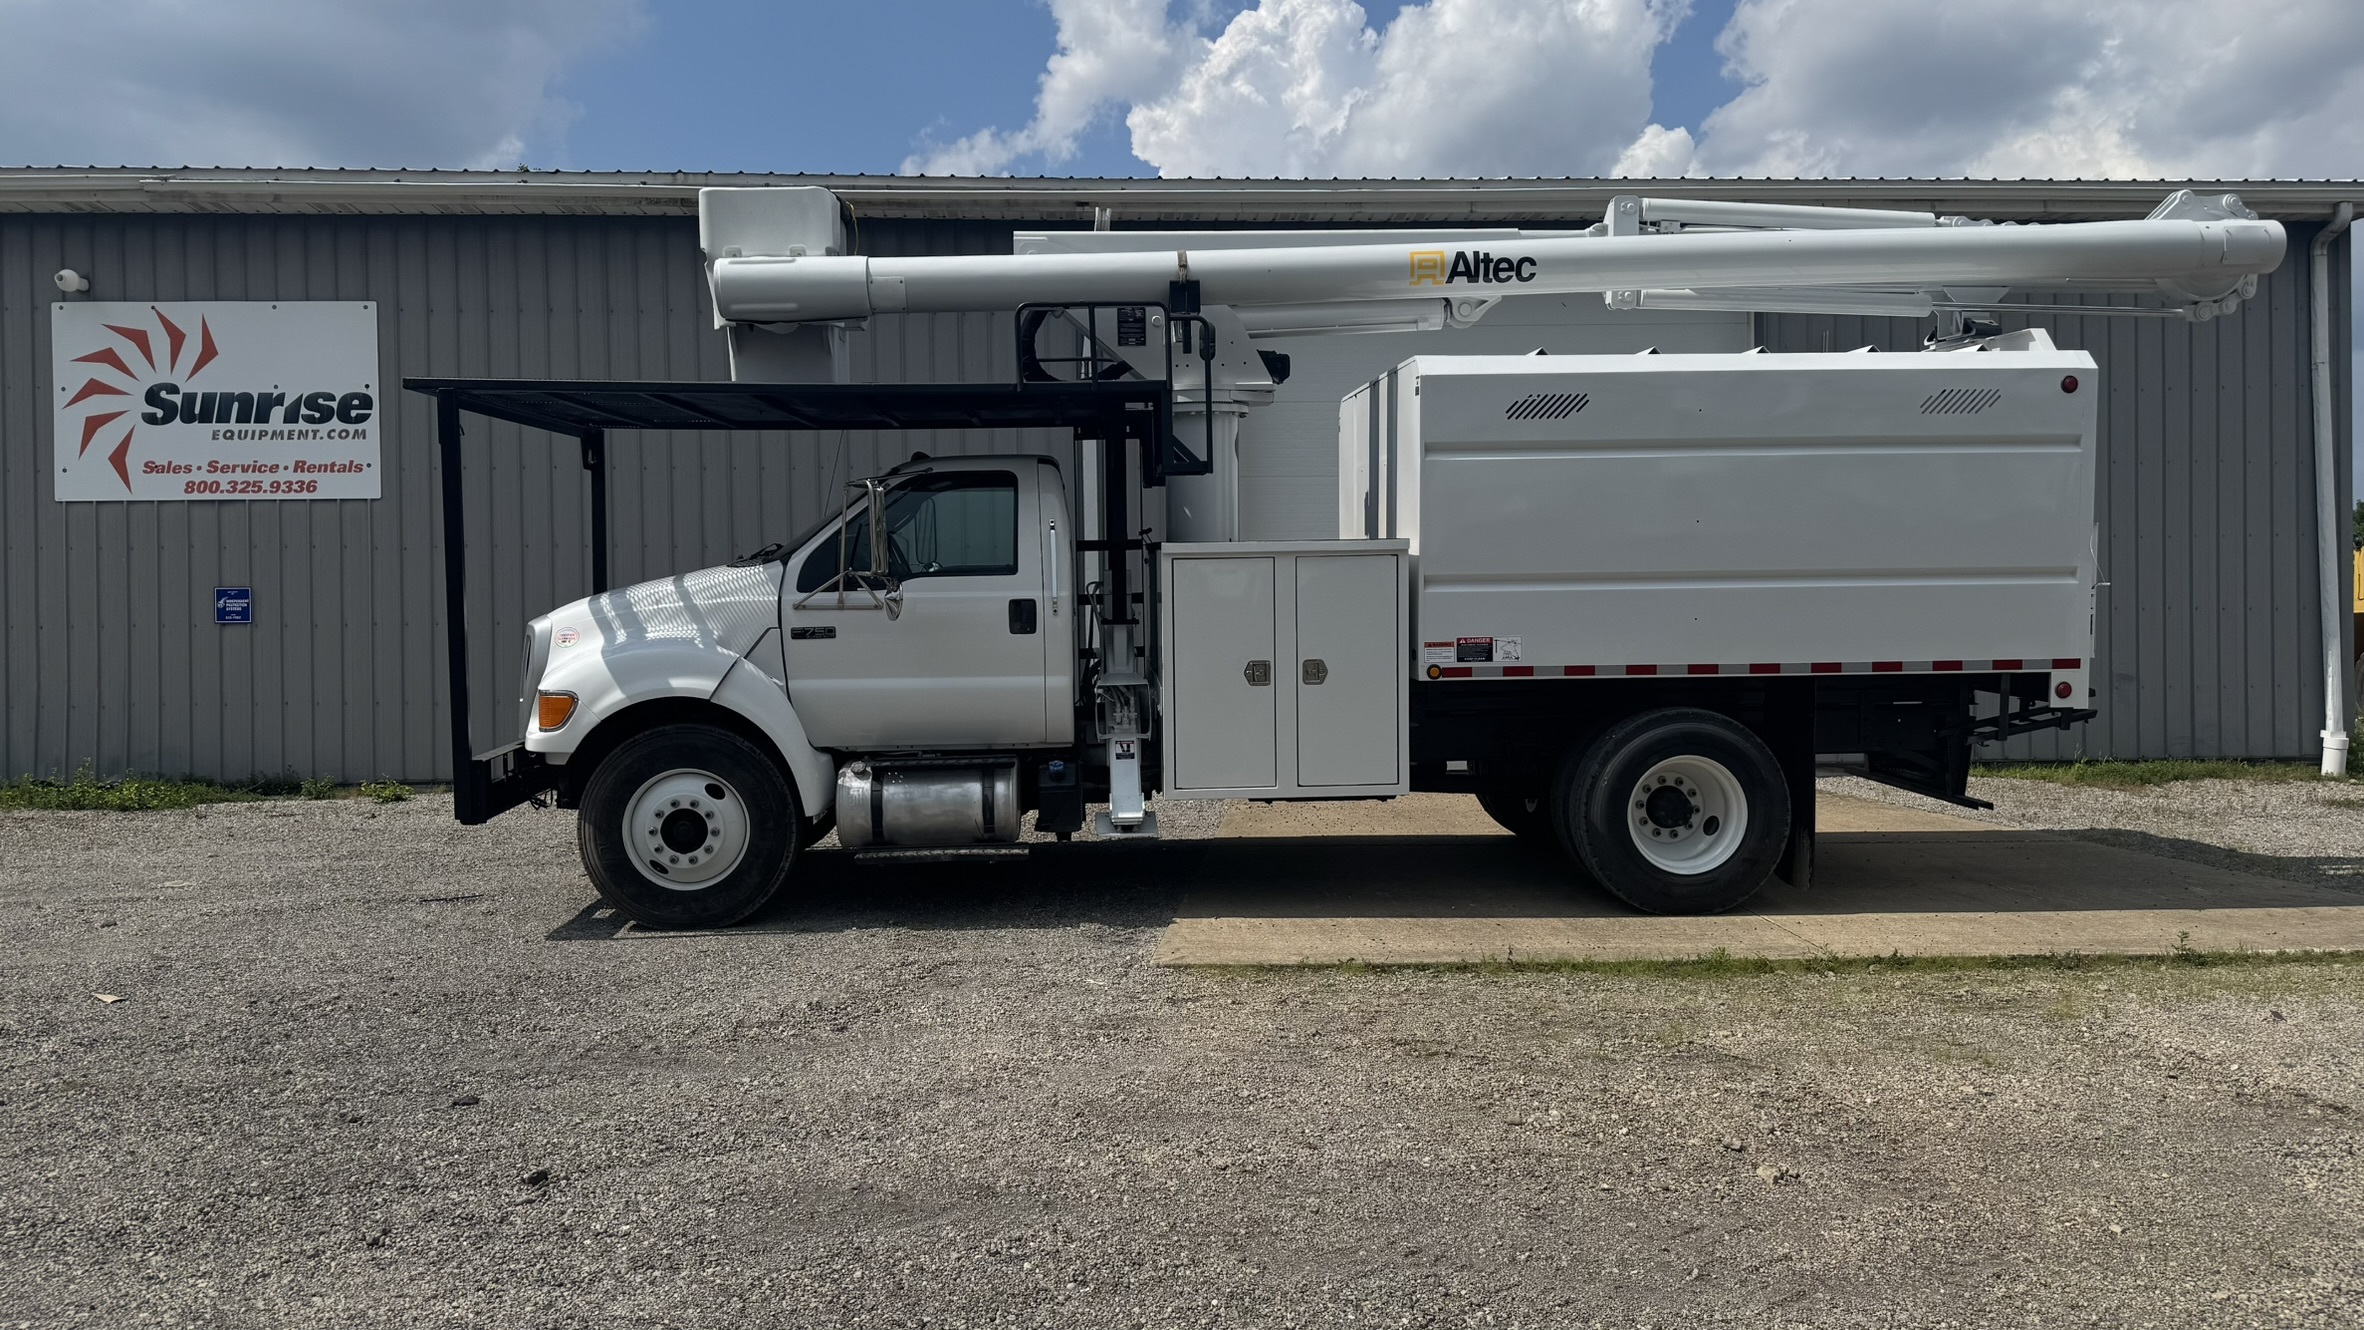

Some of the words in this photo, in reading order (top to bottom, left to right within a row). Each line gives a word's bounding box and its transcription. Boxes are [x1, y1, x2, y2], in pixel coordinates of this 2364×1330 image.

[1445, 250, 1537, 284] Altec
[141, 382, 374, 425] Sunrise
[211, 428, 367, 441] EQUIPMENT.COM
[142, 460, 193, 474] Sales
[206, 459, 280, 474] Service
[293, 460, 364, 474] Rentals
[183, 479, 318, 494] 800.325.9336
